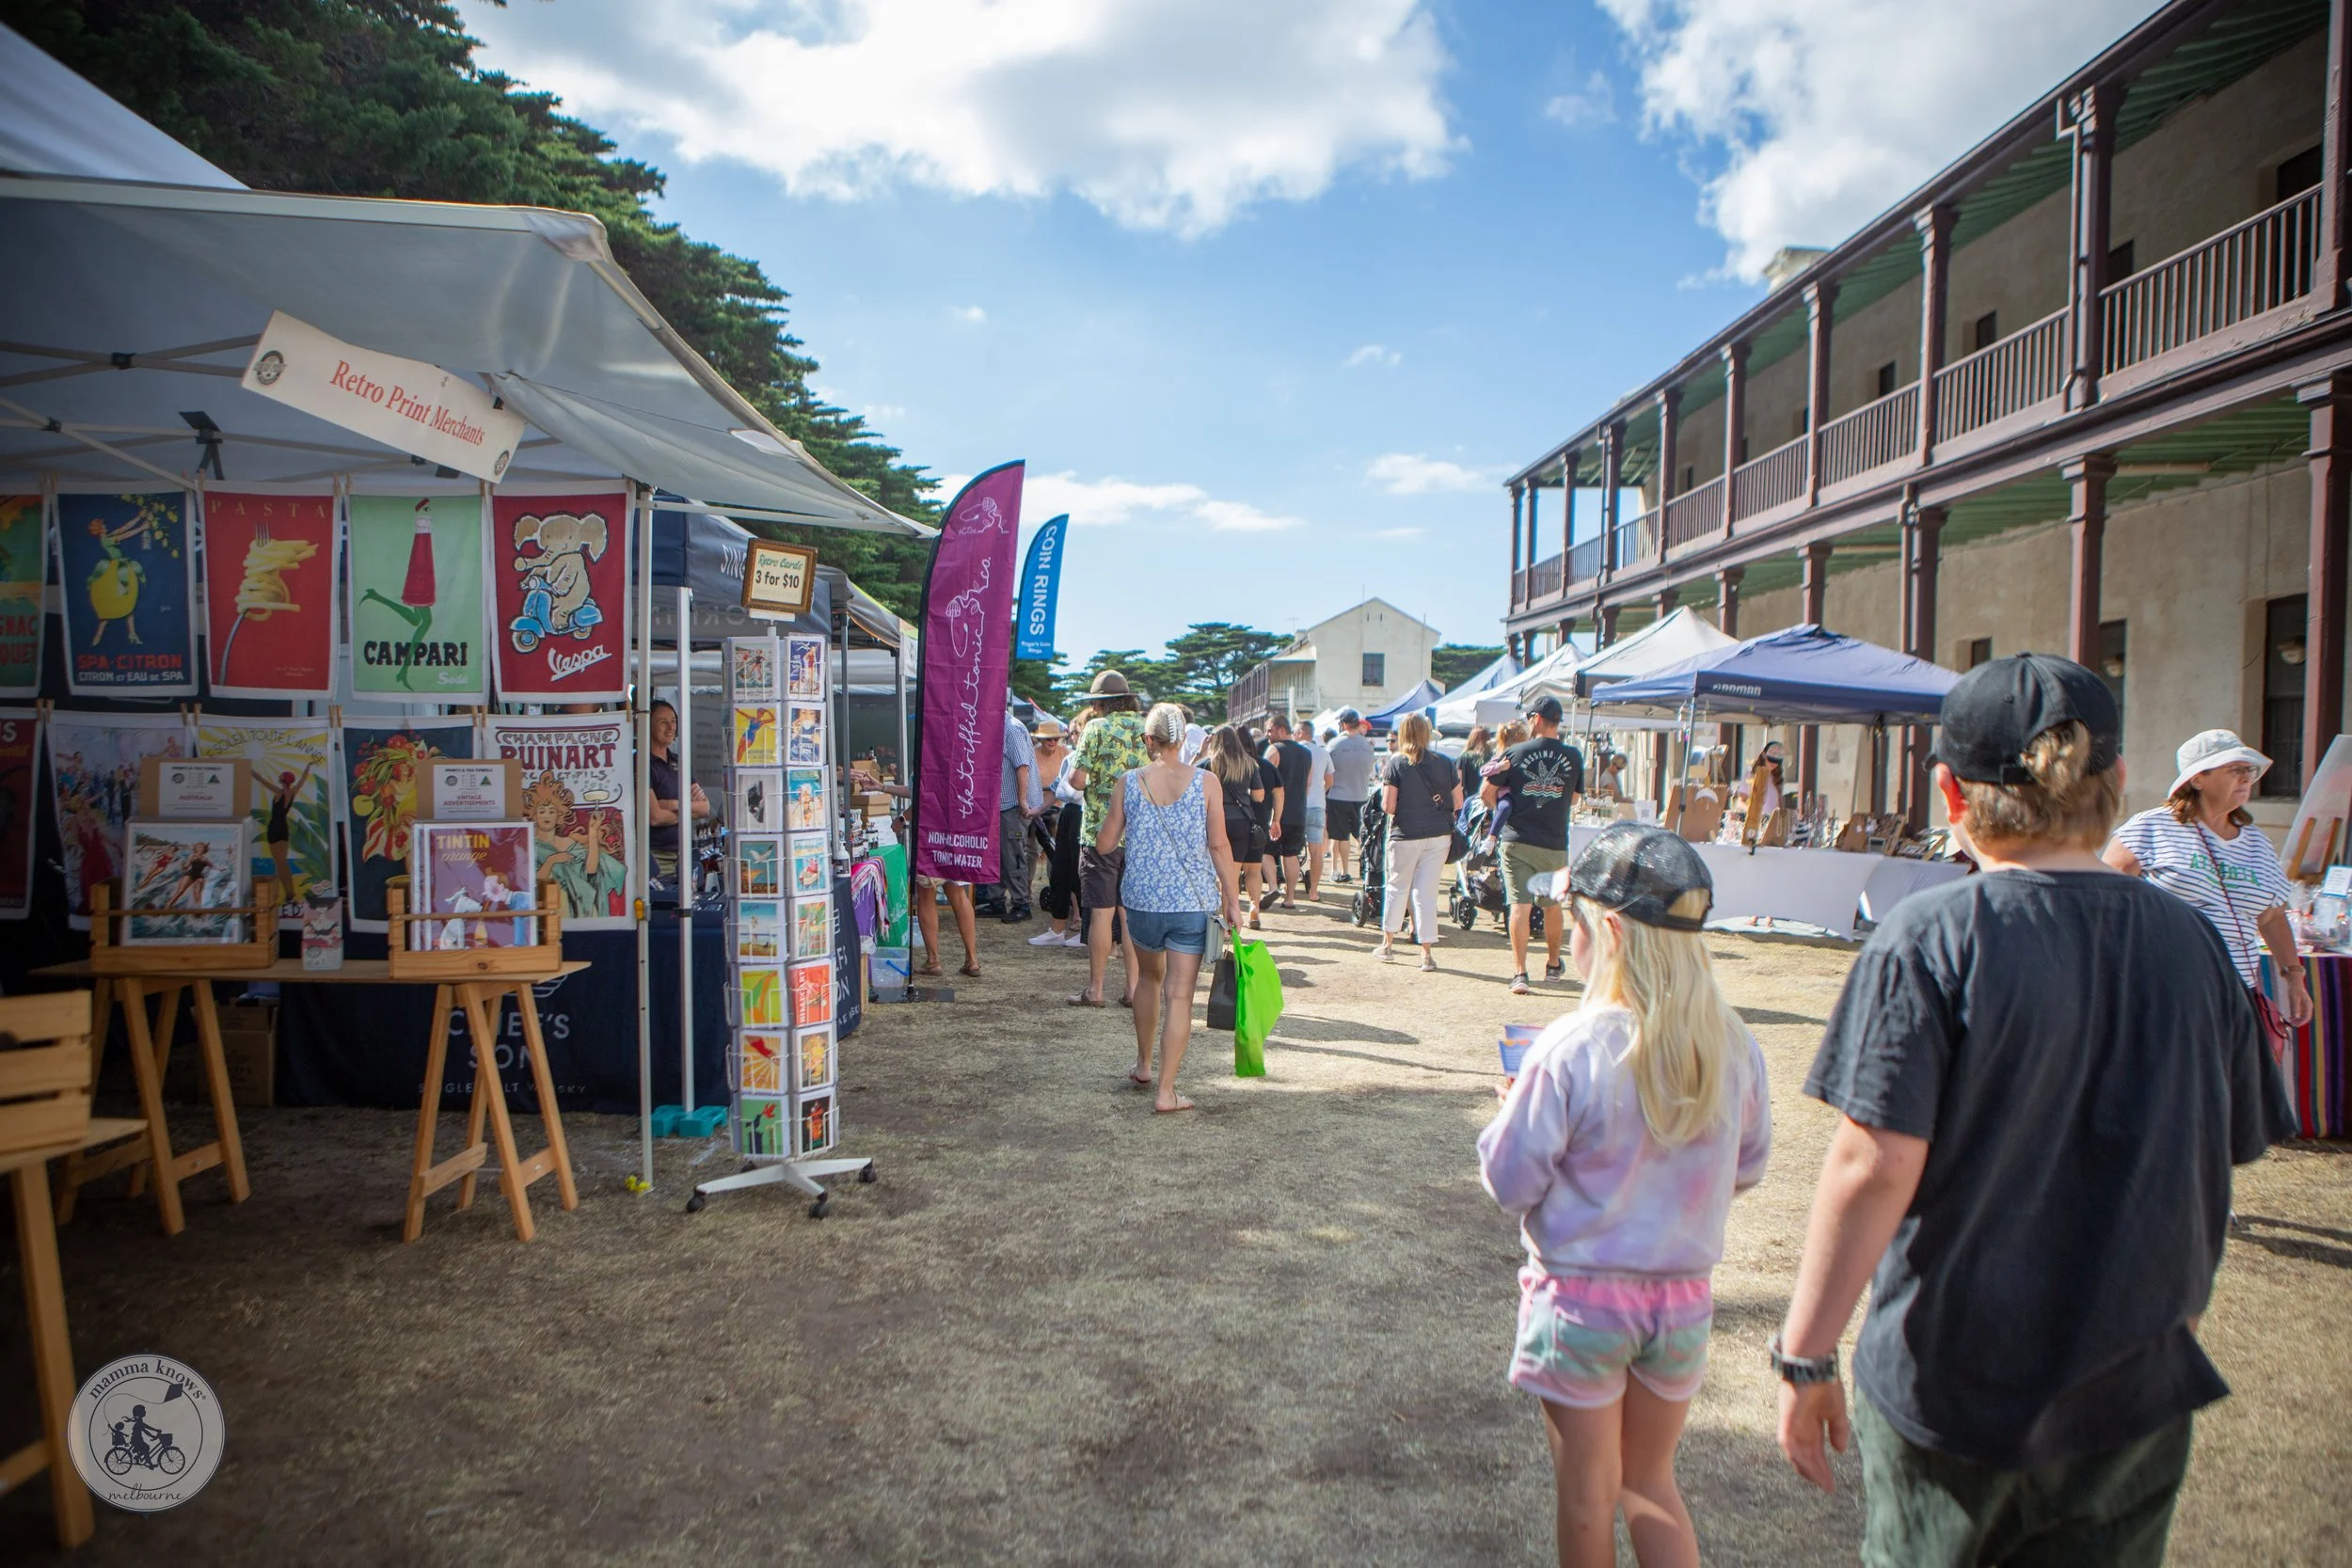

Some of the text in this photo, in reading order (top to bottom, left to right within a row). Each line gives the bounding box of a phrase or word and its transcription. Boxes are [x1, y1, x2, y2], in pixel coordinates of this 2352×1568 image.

[328, 359, 385, 403] Retro
[386, 385, 432, 423] Print
[428, 404, 485, 446] Merchants
[211, 500, 326, 518] PASTA
[779, 558, 803, 571] Cards
[755, 570, 800, 590] 3 for $10
[1029, 525, 1057, 636] COIN RINGS
[363, 641, 469, 667] CAMPARI
[548, 644, 612, 682] Vespa
[79, 672, 114, 682] CITRON
[127, 672, 148, 682] EAU
[162, 671, 184, 682] SPA
[437, 672, 469, 686] Soda
[250, 729, 285, 744] TOUTE
[501, 731, 613, 745] CHAMPAGNE
[500, 743, 617, 770] RUINART
[437, 834, 490, 849] TINTIN
[928, 831, 989, 849] NON-ALCOHOLIC
[440, 850, 487, 869] orange
[932, 850, 983, 868] TONIC WATER
